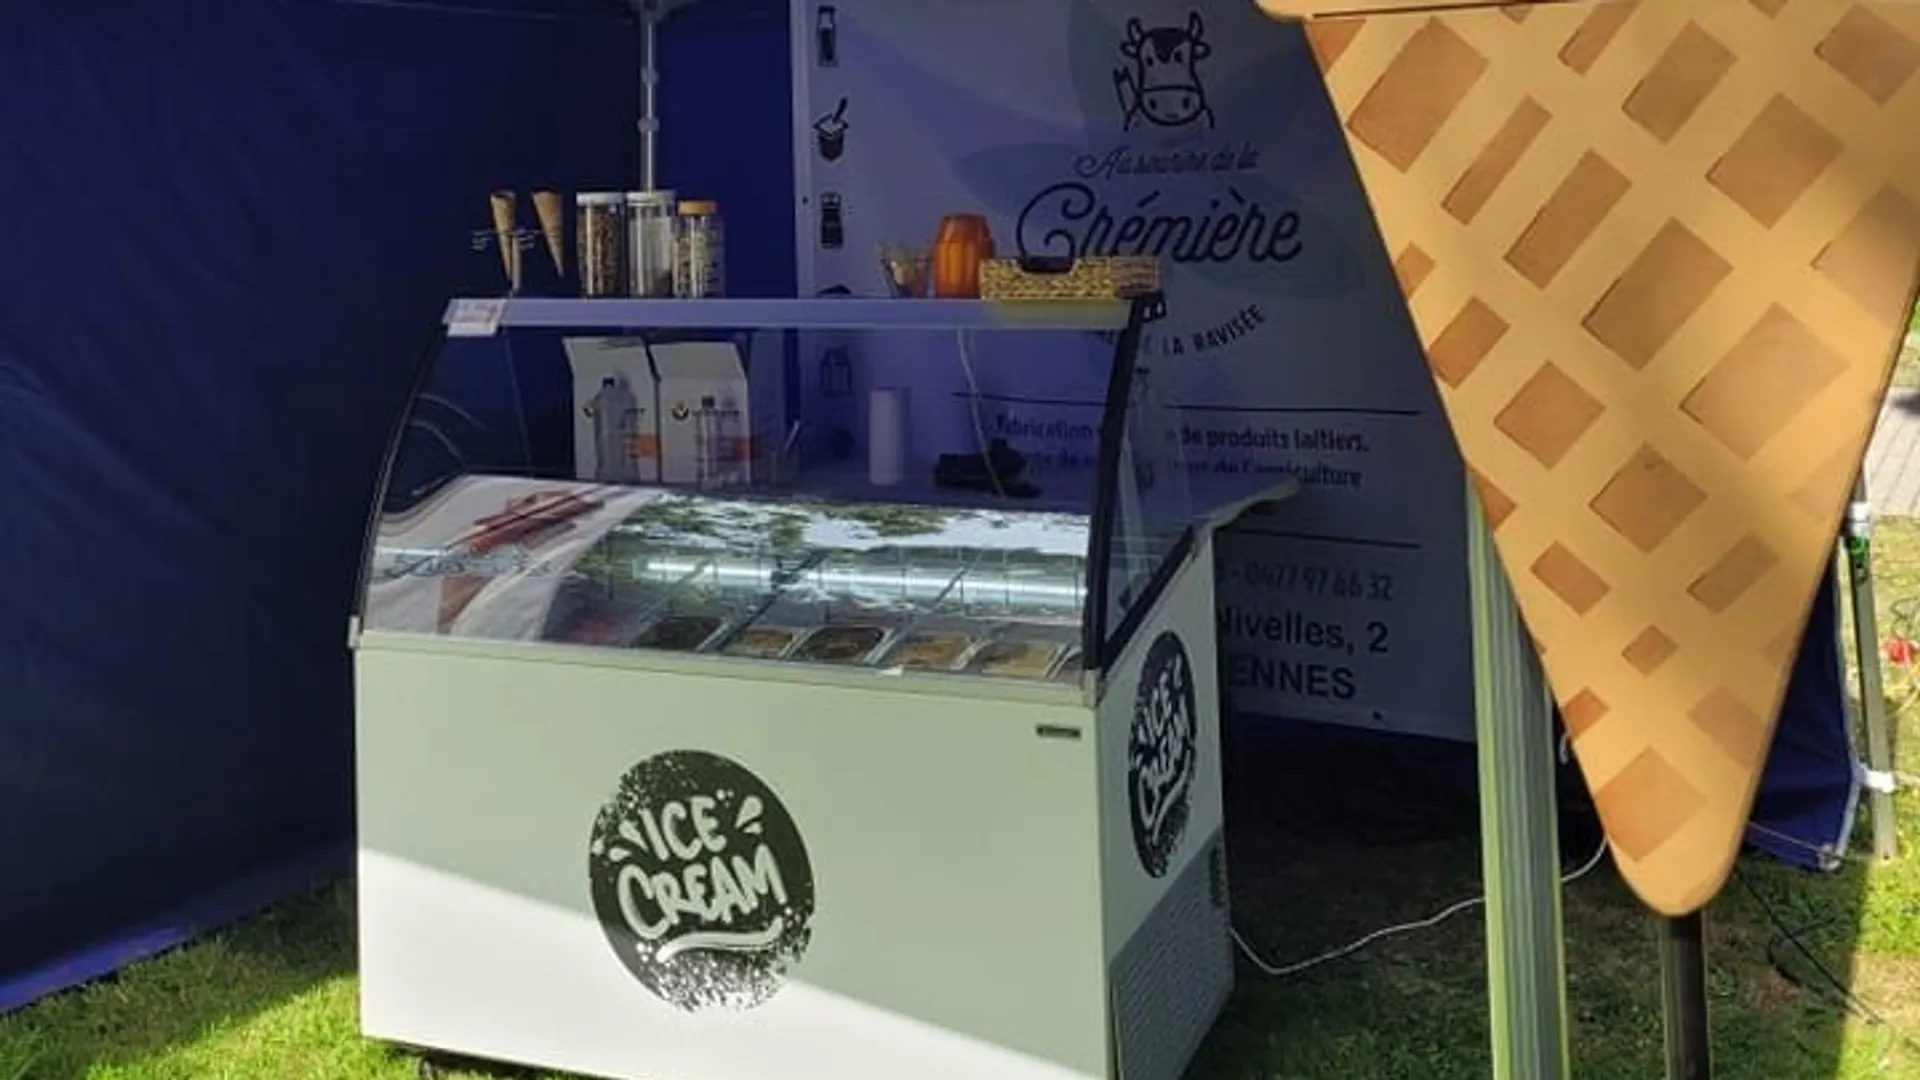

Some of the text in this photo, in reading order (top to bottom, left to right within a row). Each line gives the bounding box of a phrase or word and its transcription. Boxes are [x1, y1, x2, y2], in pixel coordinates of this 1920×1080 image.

[1016, 181, 1302, 263] Crémière
[1205, 425, 1289, 449] produits
[1365, 619, 1390, 654] 2
[1143, 670, 1172, 747] ICE
[638, 795, 727, 861] ICE
[617, 843, 787, 940] CREAM
